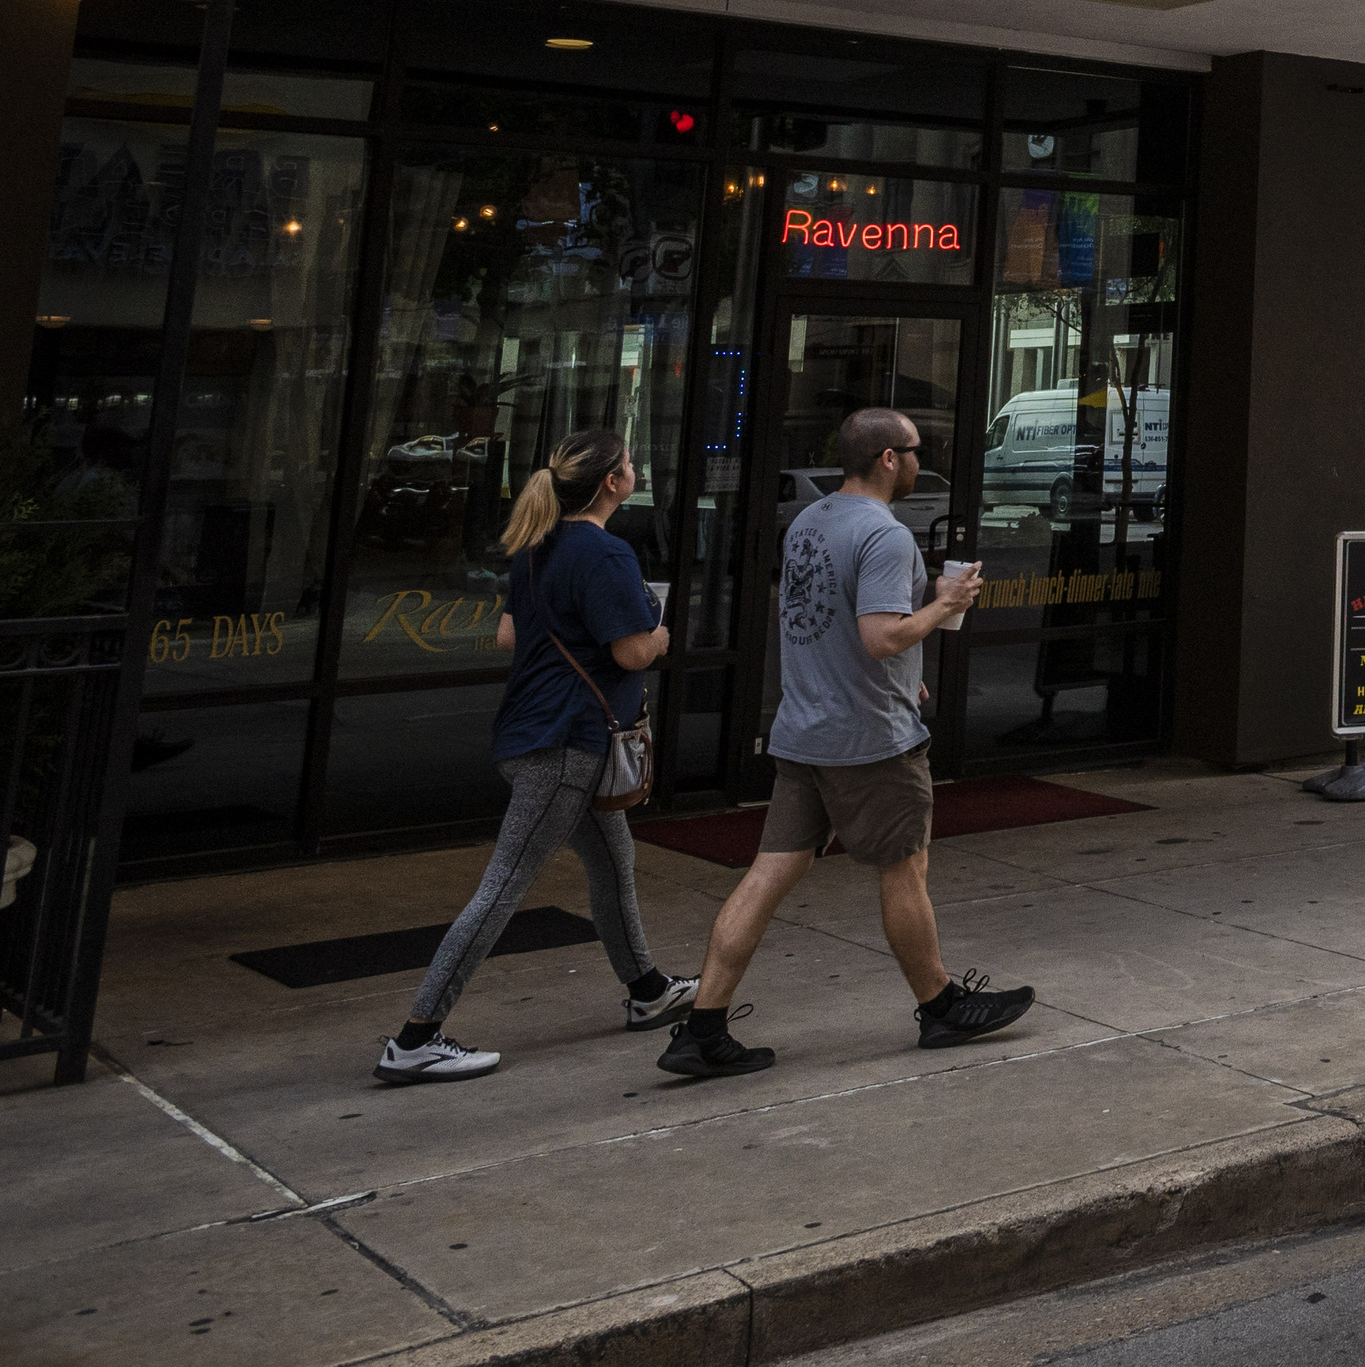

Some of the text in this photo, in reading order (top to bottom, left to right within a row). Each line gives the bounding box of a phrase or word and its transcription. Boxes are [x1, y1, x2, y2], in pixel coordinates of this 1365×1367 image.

[781, 208, 962, 251] Ravenna
[1037, 425, 1059, 437] FIBER
[821, 548, 838, 595] AMERICA
[208, 610, 286, 661] DAYS
